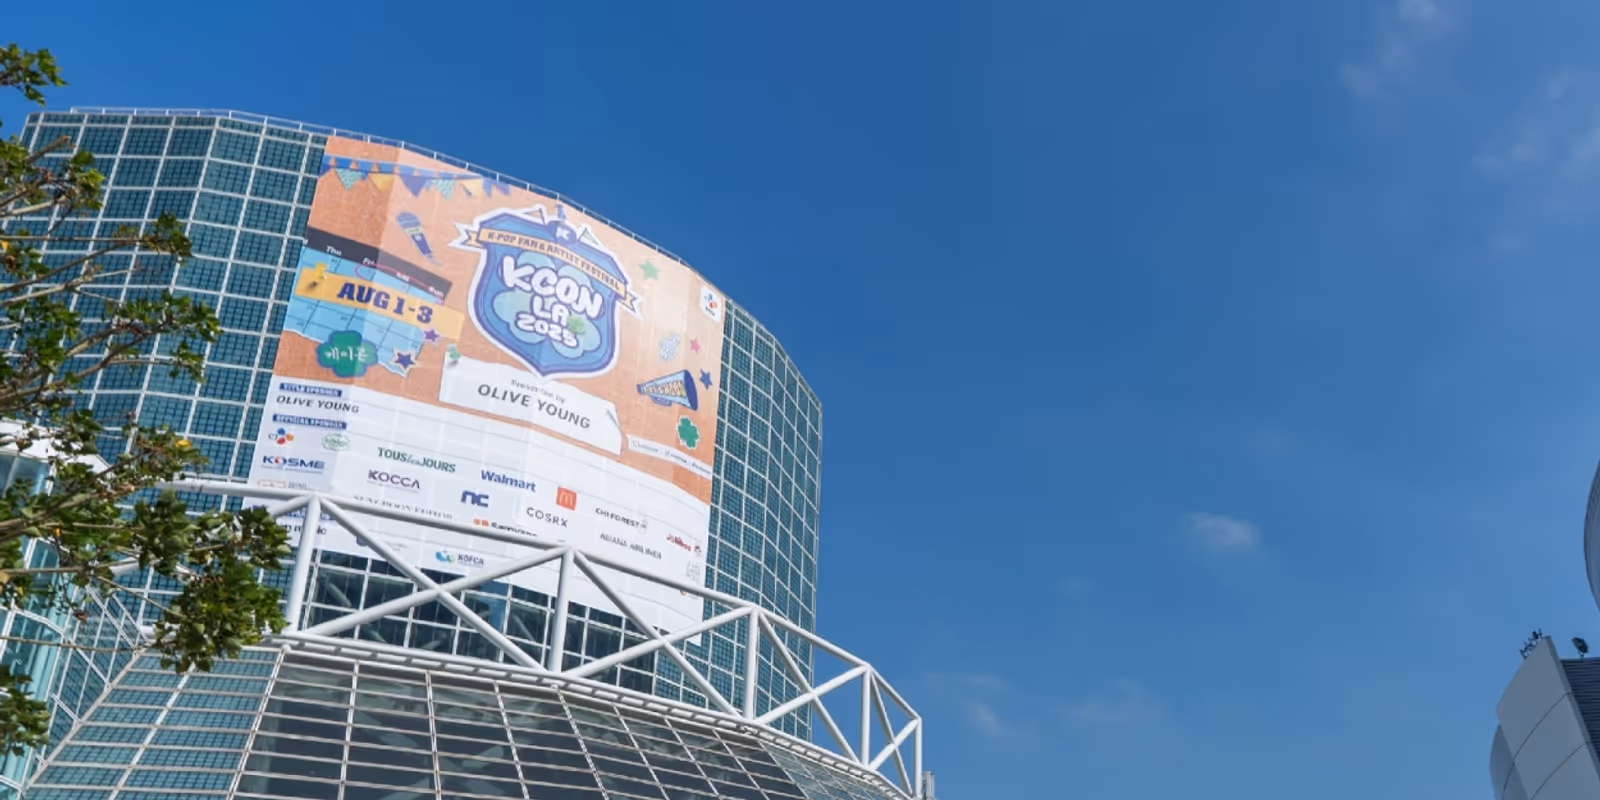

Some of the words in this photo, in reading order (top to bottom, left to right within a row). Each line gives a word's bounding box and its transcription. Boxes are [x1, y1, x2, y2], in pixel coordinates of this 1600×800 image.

[326, 245, 342, 256] Thu
[487, 231, 516, 242] K-POP
[518, 237, 538, 249] FAN
[546, 245, 579, 265] ARTIST
[580, 260, 620, 291] FESTIVAL
[337, 282, 391, 310] AUG
[502, 254, 604, 319] KCON
[533, 295, 569, 326] LA
[516, 313, 578, 348] 2025
[276, 395, 313, 407] OLIVE
[318, 399, 359, 413] YOUNG
[477, 384, 531, 407] OLIVE
[537, 399, 591, 429] YOUNG
[263, 455, 325, 470] KOSME
[368, 469, 420, 489] KOCCA
[481, 469, 536, 493] Walmart
[526, 506, 568, 528] COSRX
[610, 512, 640, 529] FOREST
